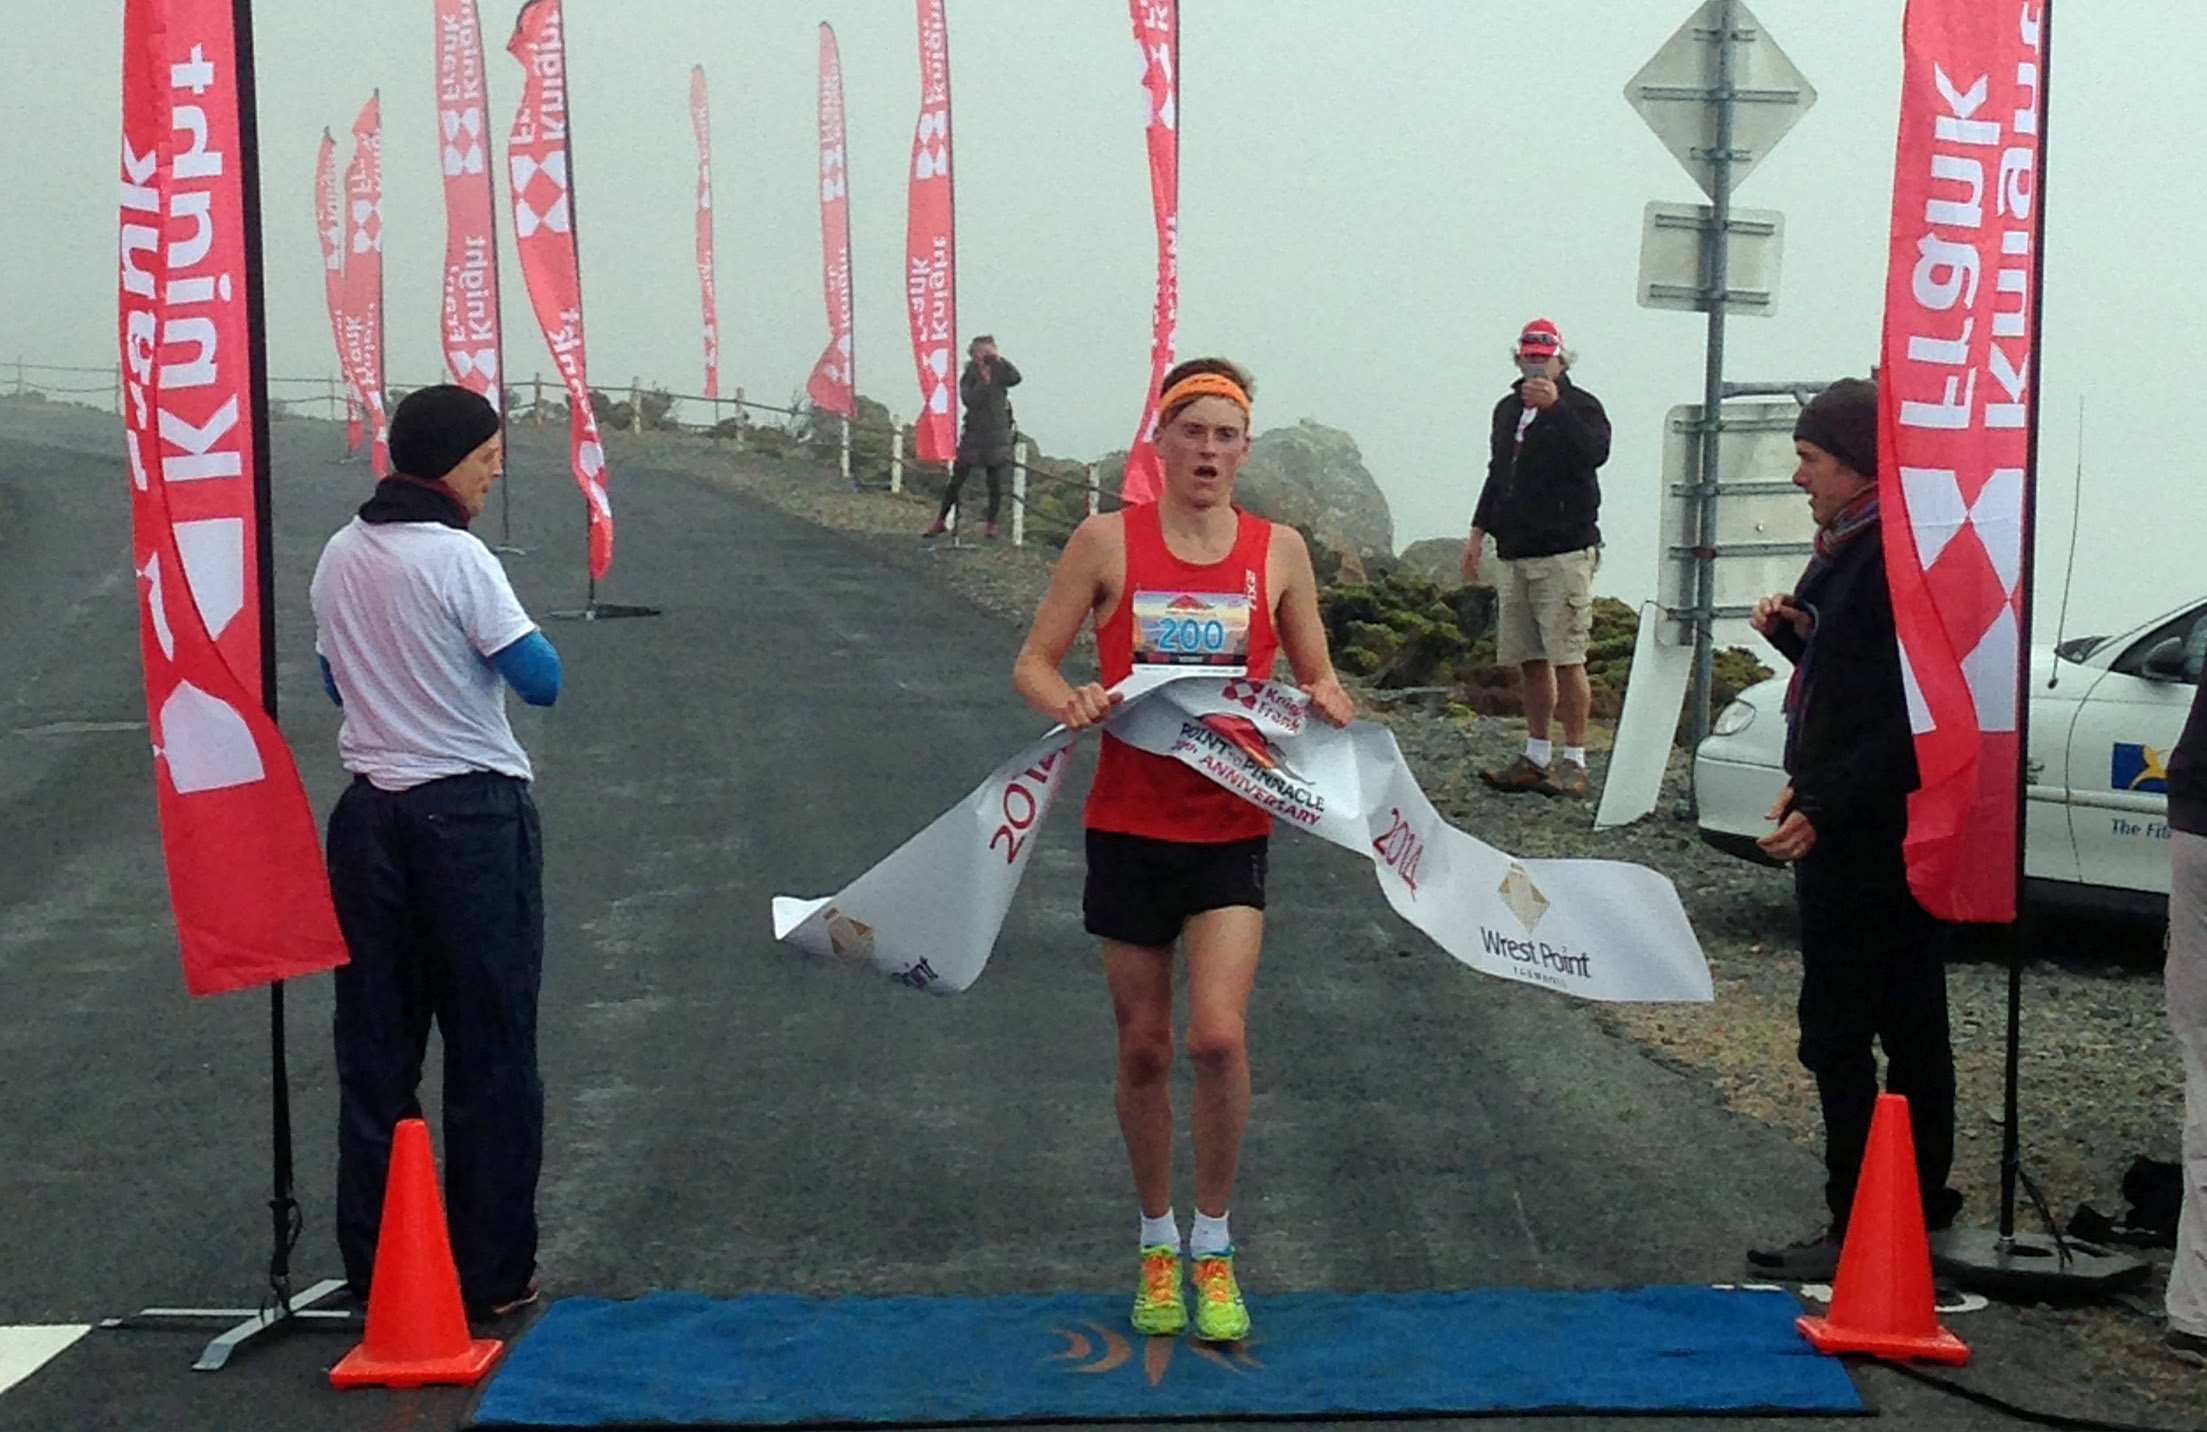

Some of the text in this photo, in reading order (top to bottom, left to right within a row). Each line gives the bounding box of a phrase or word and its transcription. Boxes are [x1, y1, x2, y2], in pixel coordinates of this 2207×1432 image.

[1157, 616, 1223, 651] 200
[1264, 687, 1306, 718] Knig
[1180, 721, 1230, 756] POINT
[1243, 760, 1325, 813] PINNACLE
[1200, 754, 1321, 826] ANNIVERSARY
[1372, 807, 1424, 903] 2014
[1480, 925, 1592, 979] Wrest Point
